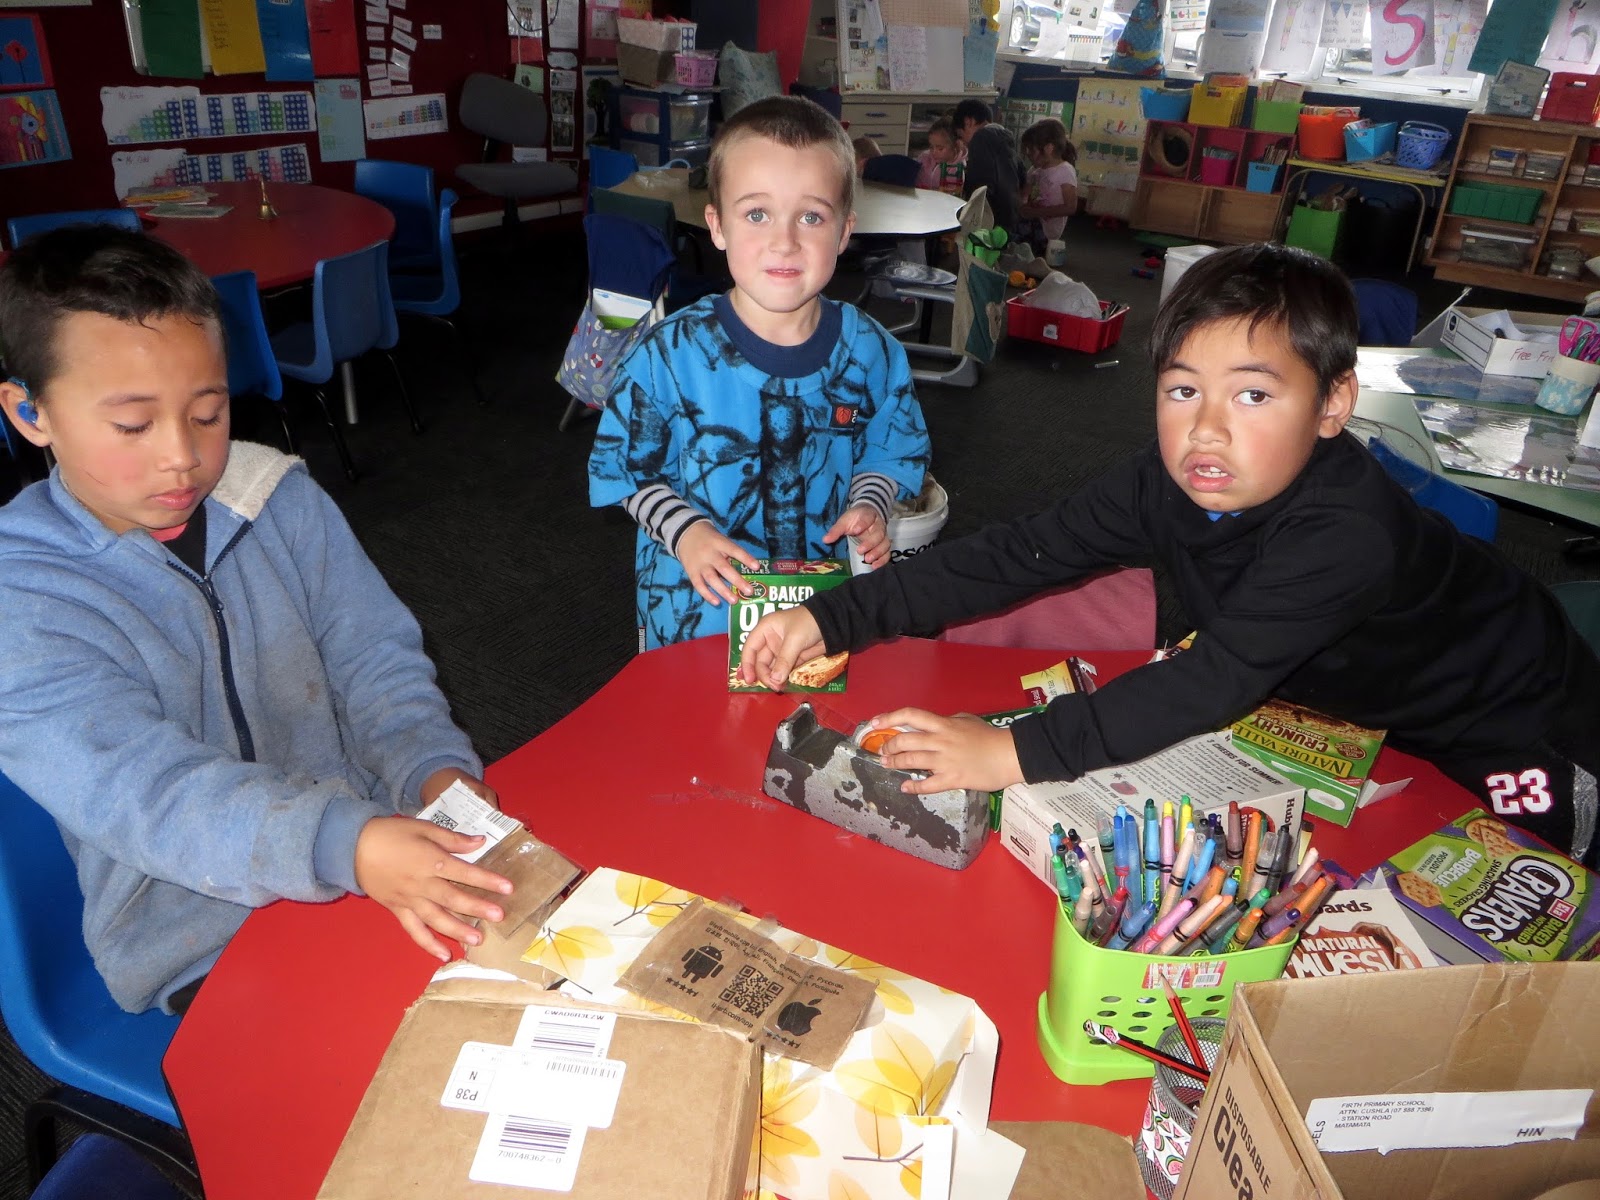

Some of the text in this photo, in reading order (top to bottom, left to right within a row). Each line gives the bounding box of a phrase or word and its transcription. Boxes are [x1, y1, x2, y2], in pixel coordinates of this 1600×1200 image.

[1510, 347, 1532, 361] Free
[769, 586, 814, 602] BAKED
[1231, 723, 1279, 751] VALLE
[1250, 714, 1329, 753] CRUNCHY
[1213, 741, 1237, 760] CHEERS
[1280, 744, 1346, 774] NATURE
[1486, 768, 1552, 814] 23
[1285, 798, 1295, 827] Hub
[1431, 851, 1448, 875] PROUDLY
[1434, 848, 1482, 887] BARBECUE
[1453, 859, 1502, 908] SNACKING CRACKERS
[1461, 857, 1571, 941] CRAVERS
[723, 929, 740, 941] mobile
[1302, 936, 1382, 952] NATURAL
[1518, 922, 1539, 944] FRIED
[1536, 918, 1563, 944] BAKED
[469, 1071, 478, 1081] N
[456, 1088, 478, 1101] P38
[1226, 1086, 1272, 1194] DISPOSABLE
[1516, 1127, 1545, 1138] HIN
[1213, 1106, 1254, 1200] Clea
